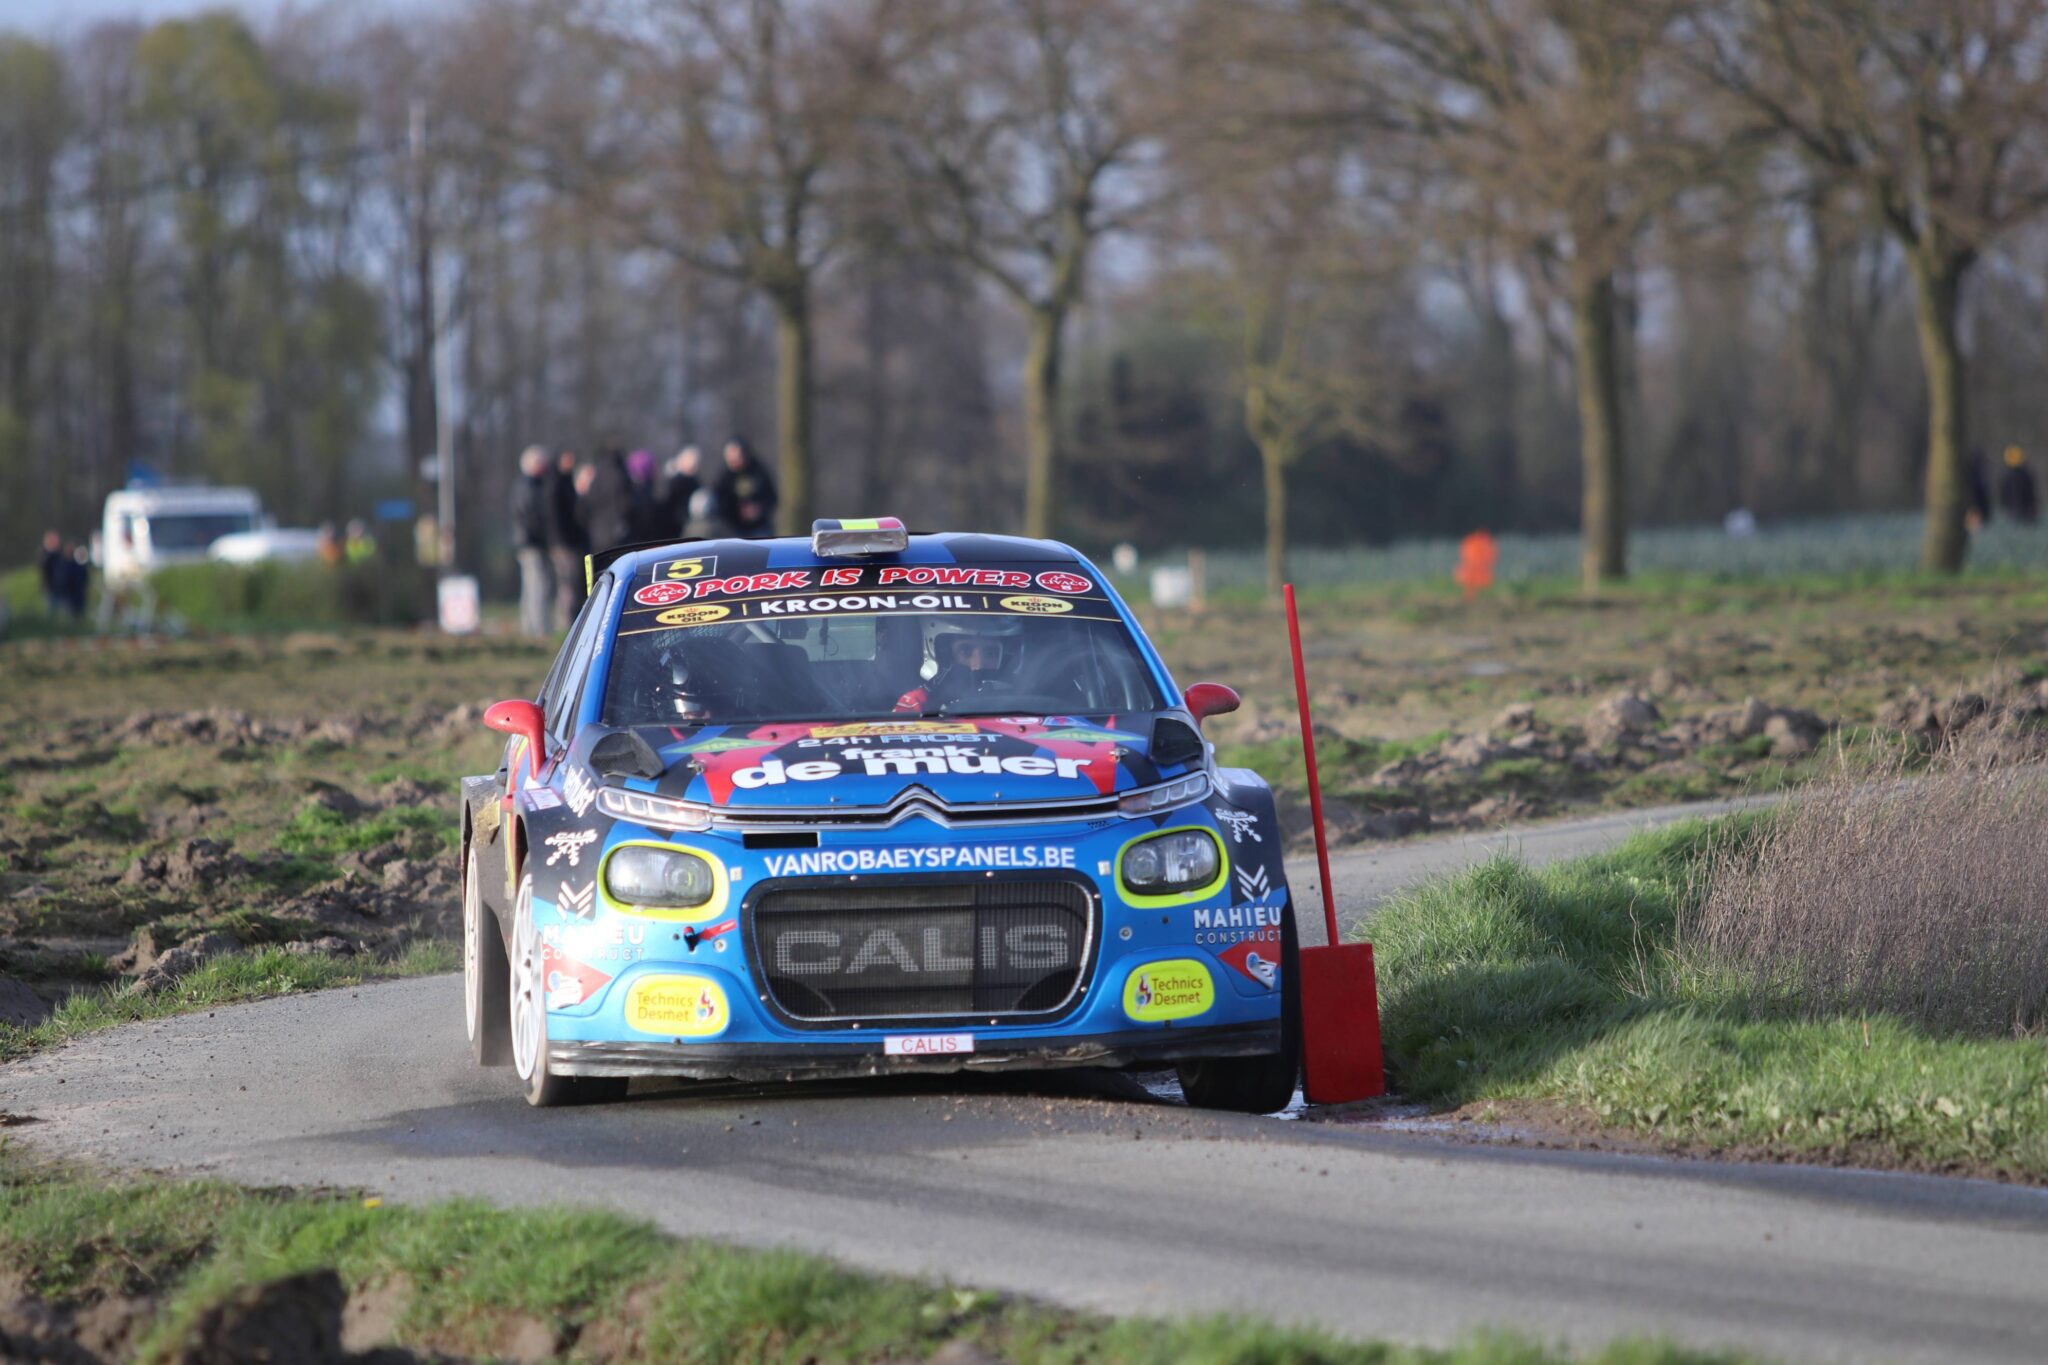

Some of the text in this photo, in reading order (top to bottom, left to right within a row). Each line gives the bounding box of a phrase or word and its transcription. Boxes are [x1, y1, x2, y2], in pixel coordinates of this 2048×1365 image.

[666, 559, 704, 579] 5
[694, 567, 1032, 598] PORK IS POWER
[760, 594, 971, 614] KROON-OIL
[667, 609, 719, 620] KROON
[797, 733, 1003, 748] 24h FROST
[840, 745, 981, 760] frank
[731, 755, 1092, 789] de muer
[764, 846, 1076, 877] VANROBAEYSPANELS.BE
[1193, 907, 1281, 929] MAHIEU
[776, 924, 1069, 975] CALIS
[1152, 975, 1203, 991] Technics
[636, 991, 694, 1007] Technics
[1154, 991, 1200, 1006] Desmet
[637, 1006, 689, 1021] Desmet
[901, 1036, 957, 1052] CALIS
